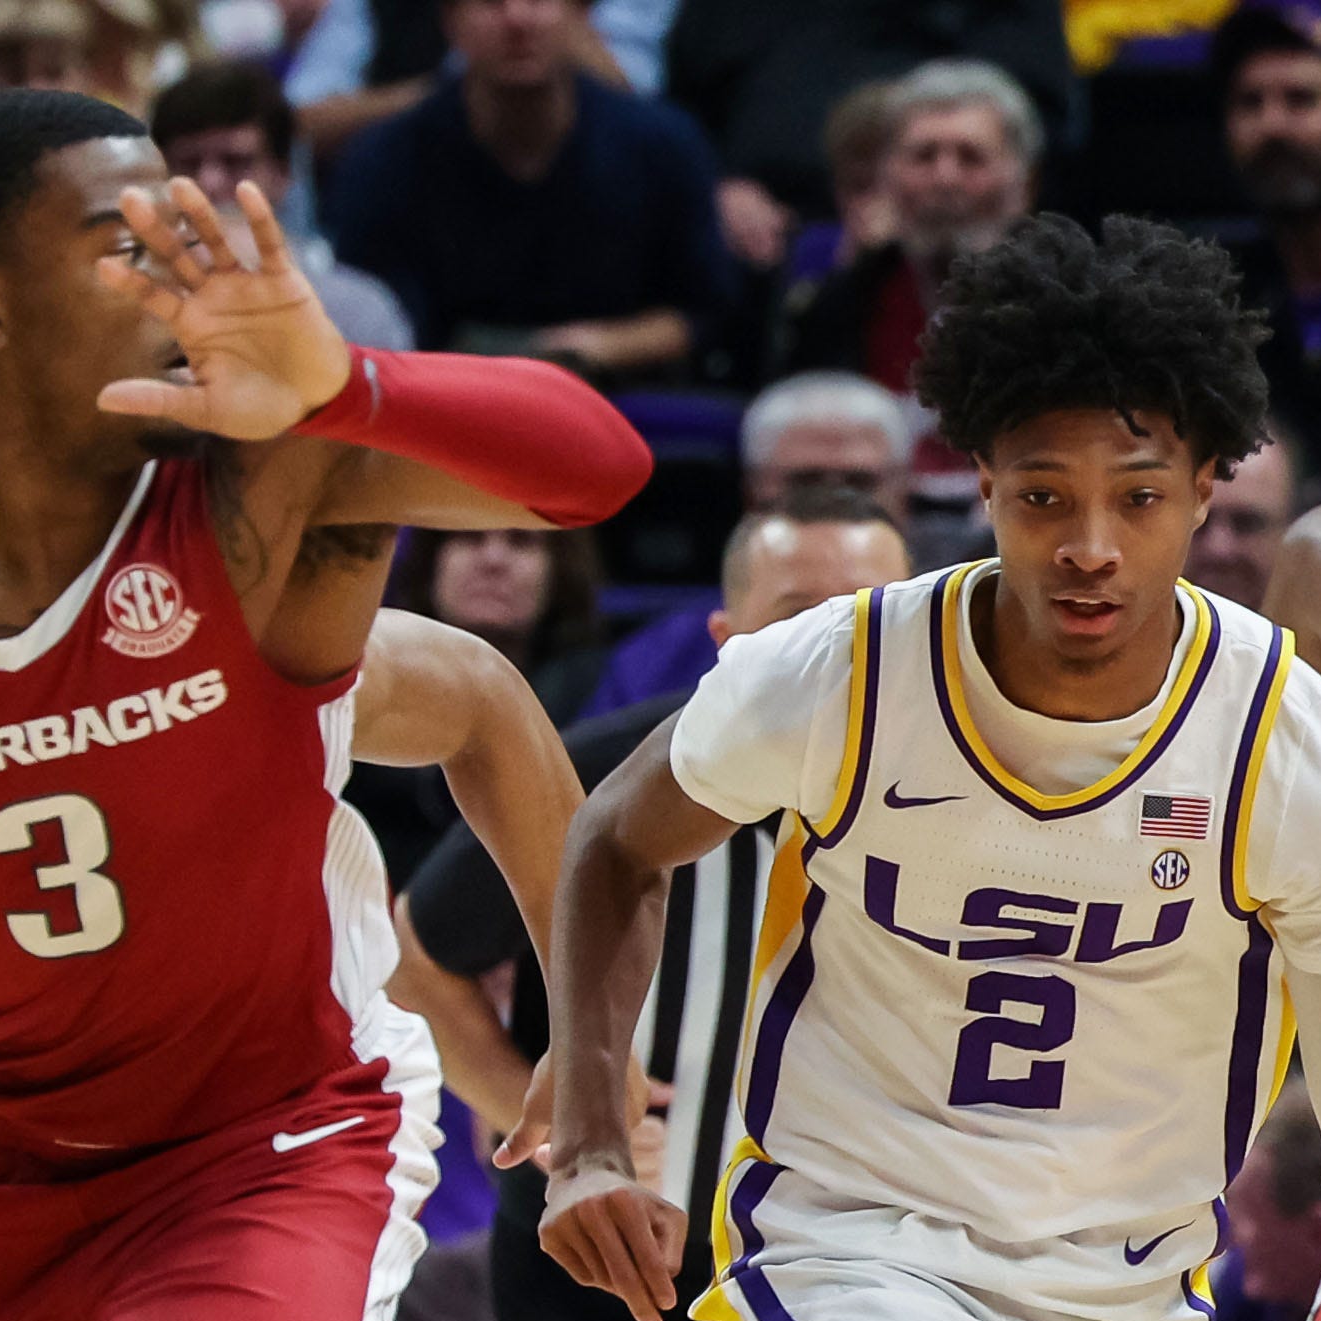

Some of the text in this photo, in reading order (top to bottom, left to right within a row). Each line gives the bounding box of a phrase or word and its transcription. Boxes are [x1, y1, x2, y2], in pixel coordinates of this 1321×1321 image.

[112, 569, 176, 632] SEC
[864, 854, 1196, 964] LSU
[1154, 852, 1188, 888] SEC
[947, 970, 1077, 1110] 2
